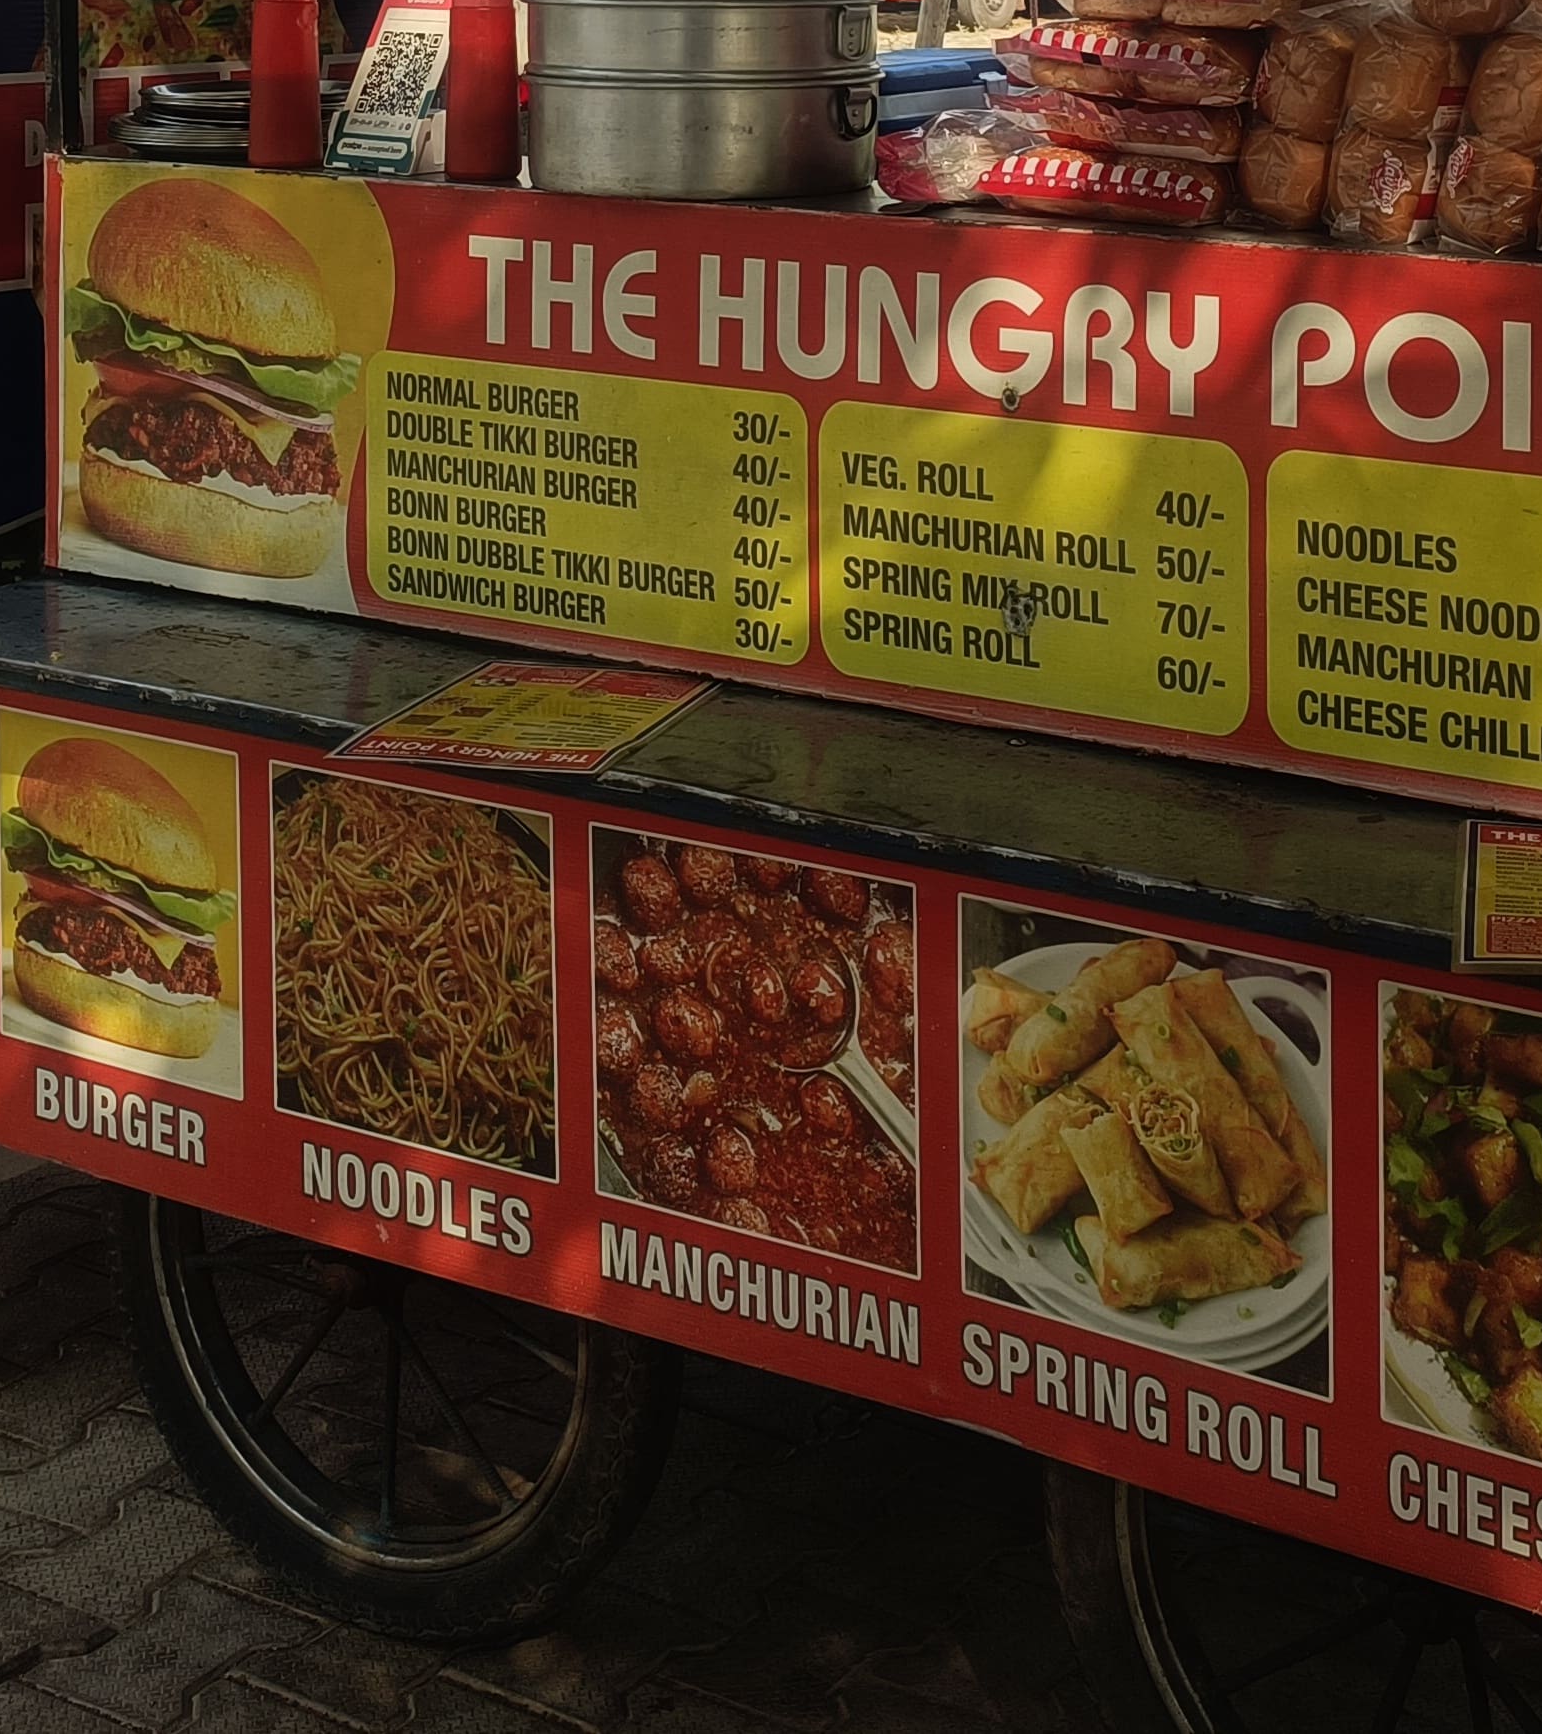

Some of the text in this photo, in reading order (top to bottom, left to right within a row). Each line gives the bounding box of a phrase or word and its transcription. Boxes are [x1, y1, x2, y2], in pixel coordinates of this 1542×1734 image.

[468, 235, 657, 361] THE
[698, 251, 1221, 418] HUNGRY
[386, 371, 792, 446] NORMAL BURGER 30/-
[386, 410, 792, 488] DOUBLE TIKKI BURGER 40/-
[386, 449, 792, 530] MANCHURIAN BURGER 40/-
[386, 487, 792, 571] BONN BURGER 40/-
[842, 451, 1226, 530] VEG. ROLL 40/-
[386, 525, 792, 612] BONN DUBBLE TIKKI BURGER 50/-
[842, 504, 1226, 586] MANCHURIAN ROLL 50/-
[1296, 519, 1459, 574] NOODLES
[386, 564, 793, 653] SANDWICH BURGER 30/-
[842, 557, 1226, 641] SPRING MIX ROLL 70/-
[1296, 576, 1428, 629] CHEESE
[843, 608, 1227, 698] SPRING ROLL 60/-
[1296, 634, 1533, 703] MANCHURIAN
[1296, 689, 1428, 744] CHEESE
[1491, 830, 1542, 844] THE
[1490, 916, 1537, 925] PIZZA
[34, 1067, 208, 1168] BURGER
[301, 1141, 534, 1257] NOODLES
[599, 1221, 921, 1367] MANCHURIAN
[961, 1321, 1339, 1500] SPRING ROLL
